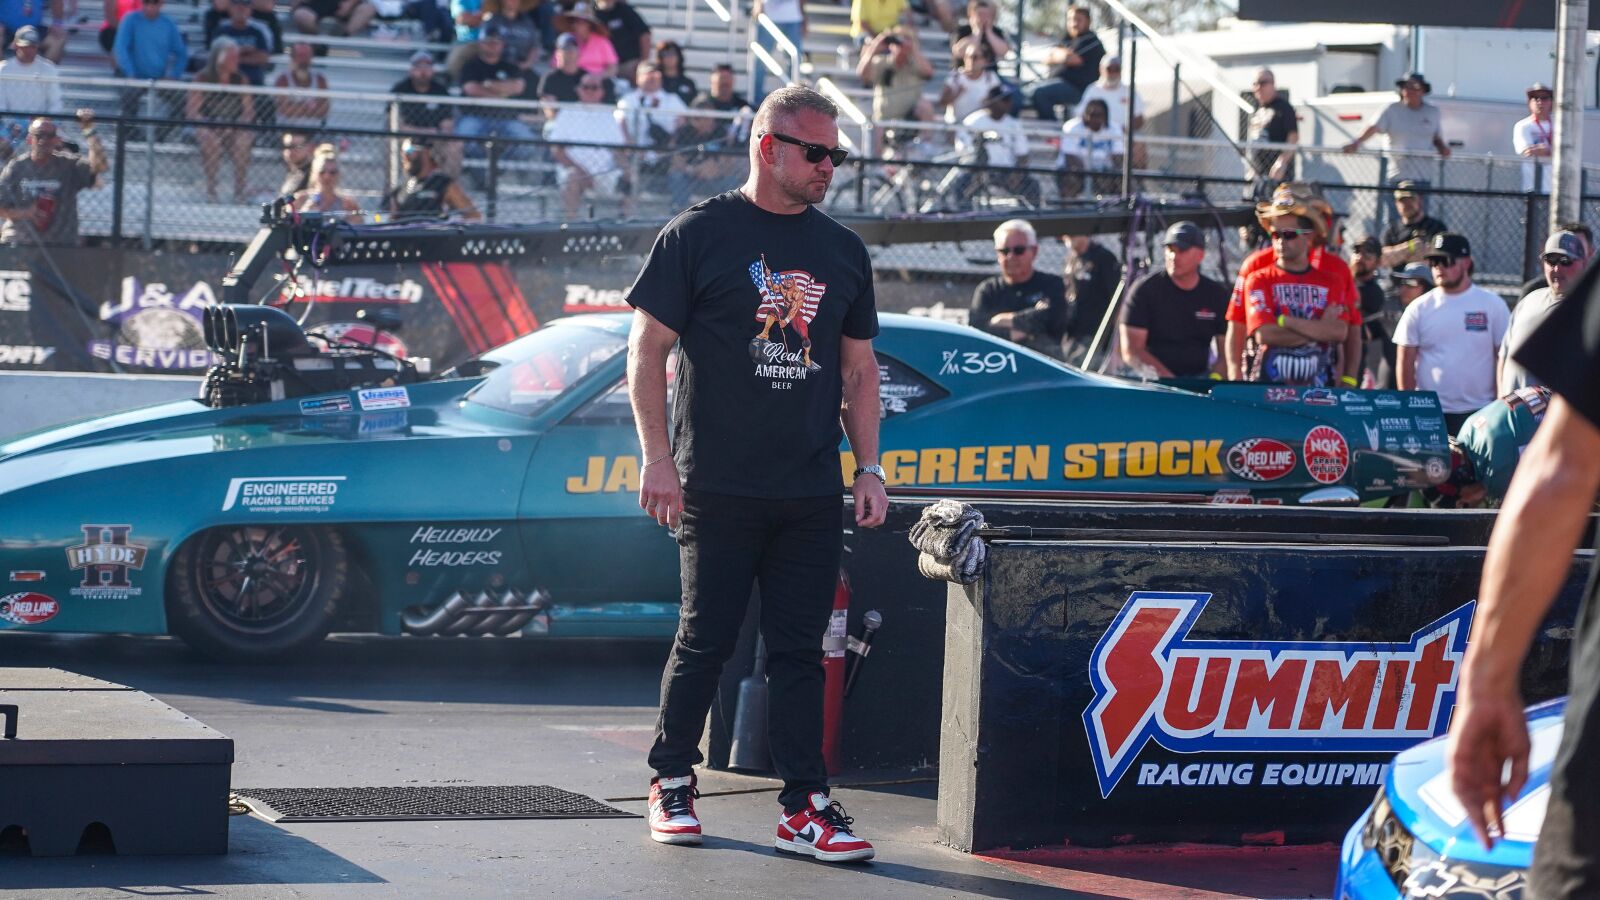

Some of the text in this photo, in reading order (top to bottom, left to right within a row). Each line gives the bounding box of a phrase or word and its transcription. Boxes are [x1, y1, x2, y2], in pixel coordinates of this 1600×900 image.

[99, 275, 219, 320] J&A
[763, 342, 802, 363] Real
[754, 363, 807, 380] AMERICAN
[962, 352, 1018, 375] 391
[771, 381, 792, 390] BEER
[1310, 438, 1342, 453] NGK
[881, 444, 1050, 486] GREEN
[1063, 439, 1224, 480] STOCK
[1247, 451, 1291, 466] RED LINE
[1313, 456, 1341, 466] SPARK
[1313, 465, 1342, 475] PLUGS
[243, 483, 338, 496] ENGINEERED
[241, 495, 335, 507] RACING SERVICES
[410, 526, 502, 543] HELLBILLY
[77, 546, 138, 564] HYDE
[408, 549, 502, 567] HEADERS
[13, 601, 56, 613] RED LINE
[1136, 763, 1255, 786] RACING
